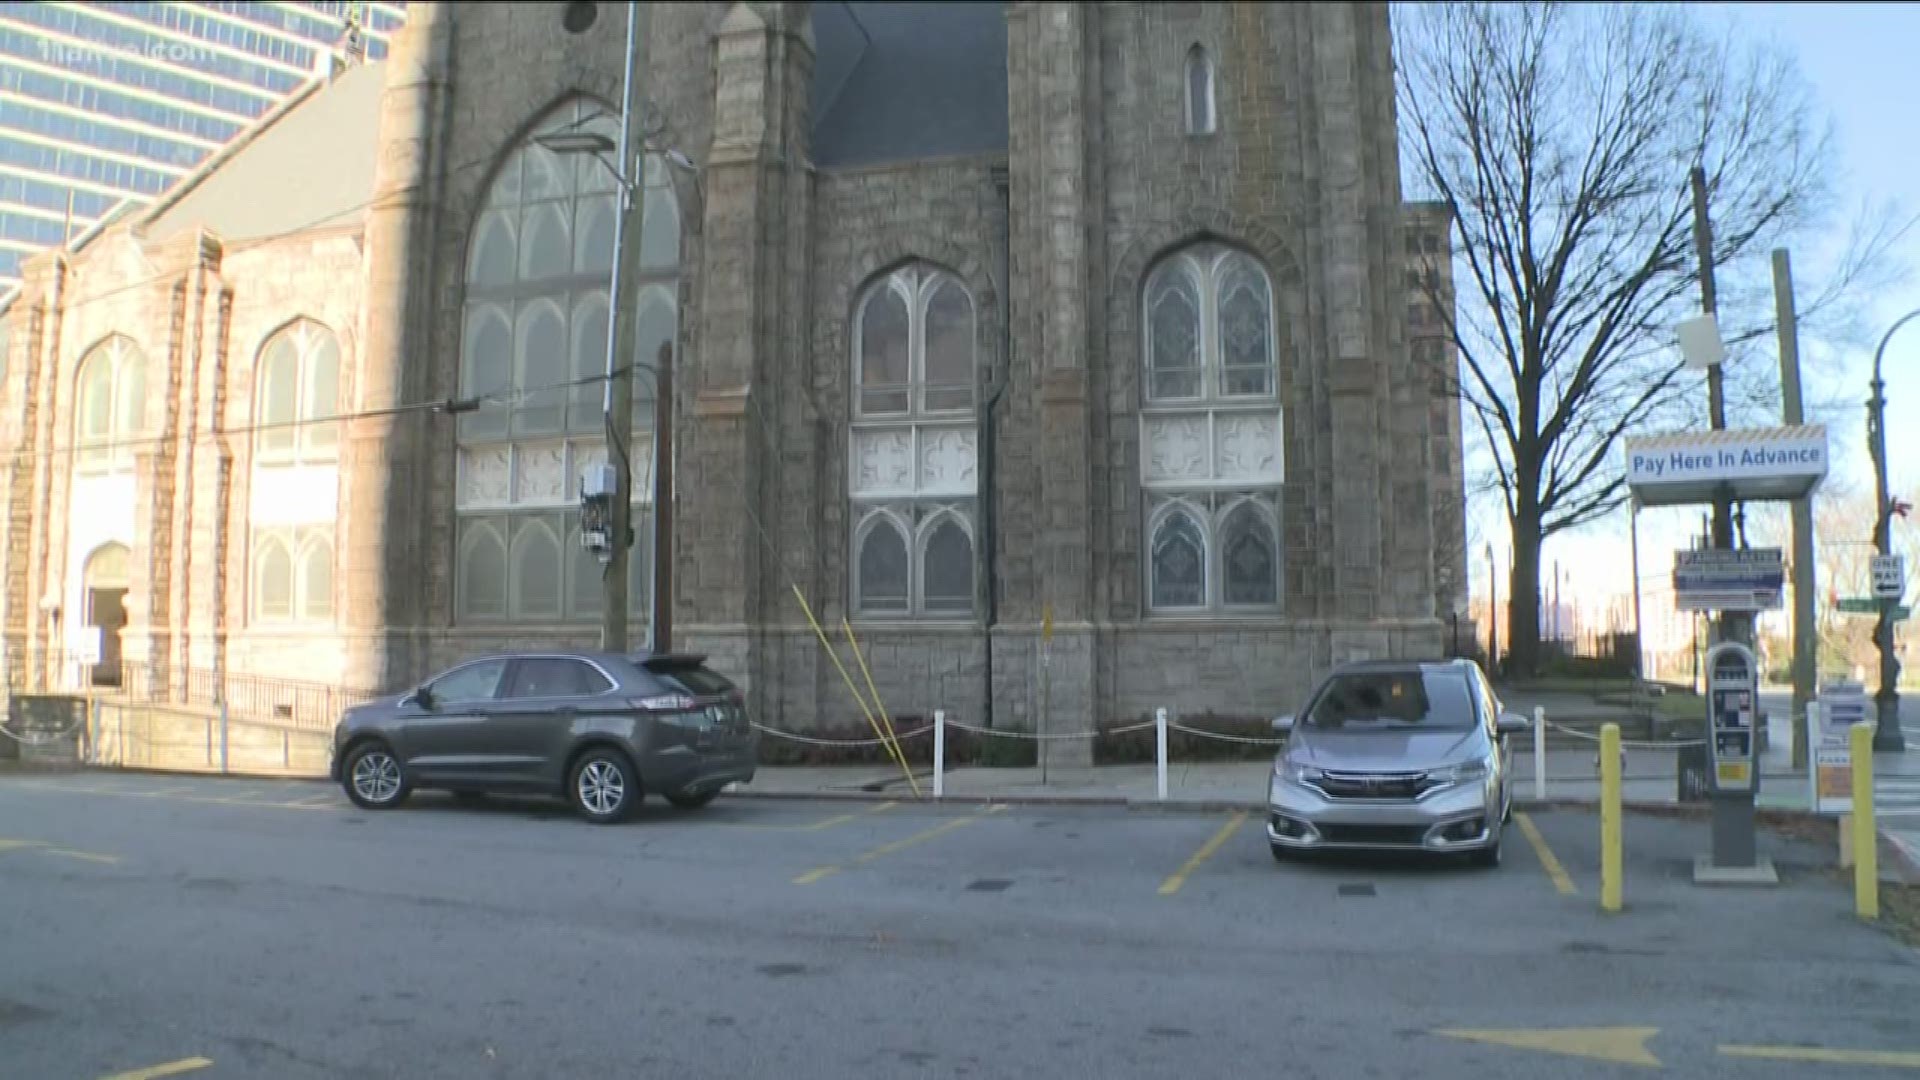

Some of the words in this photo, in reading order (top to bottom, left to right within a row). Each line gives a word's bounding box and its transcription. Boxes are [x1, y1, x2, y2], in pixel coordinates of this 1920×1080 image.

[1633, 455, 1665, 475] Pay
[1670, 452, 1713, 470] Here
[1718, 449, 1736, 467] In
[1740, 446, 1820, 466] Advance
[1872, 558, 1899, 569] ONE
[1873, 570, 1899, 581] WAY
